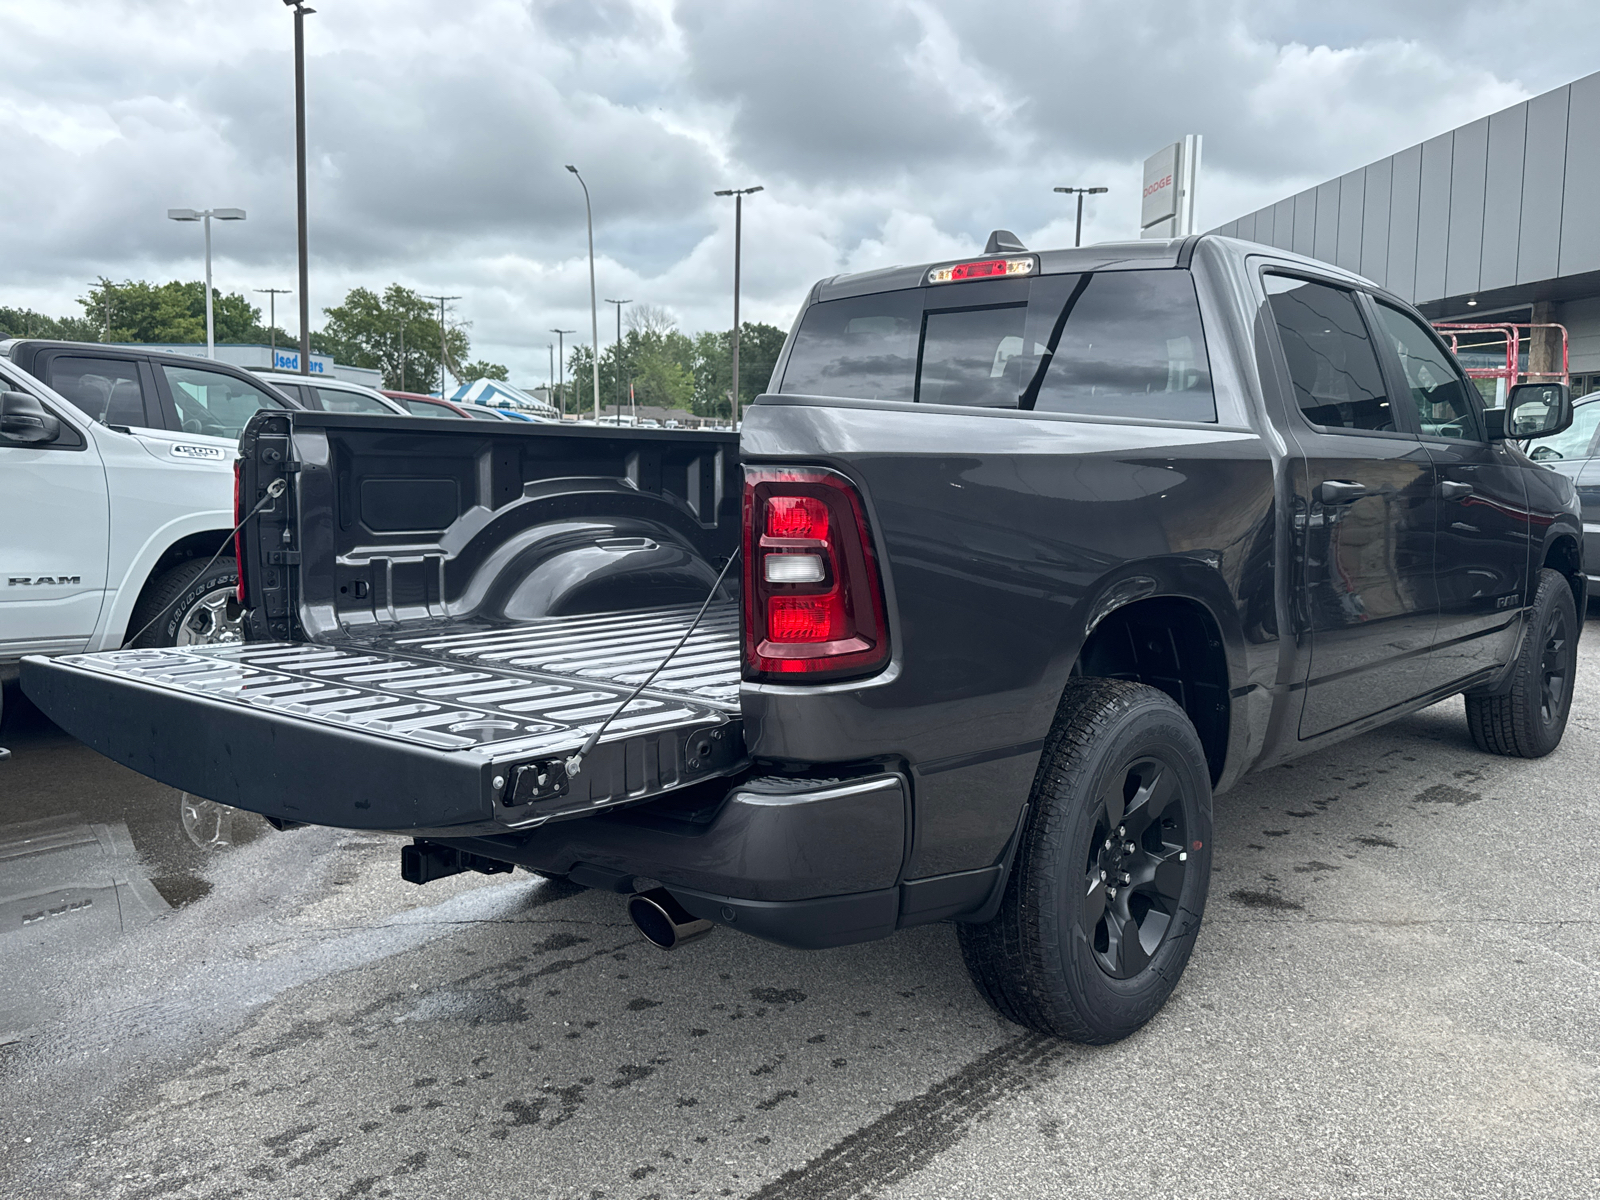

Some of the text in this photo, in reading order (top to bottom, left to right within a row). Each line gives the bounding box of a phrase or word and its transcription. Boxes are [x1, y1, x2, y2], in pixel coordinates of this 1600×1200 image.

[1143, 174, 1172, 198] DODGE
[309, 360, 324, 373] ars
[176, 445, 218, 455] 1500
[8, 575, 81, 587] RAM
[167, 574, 239, 638] BRIDGEST
